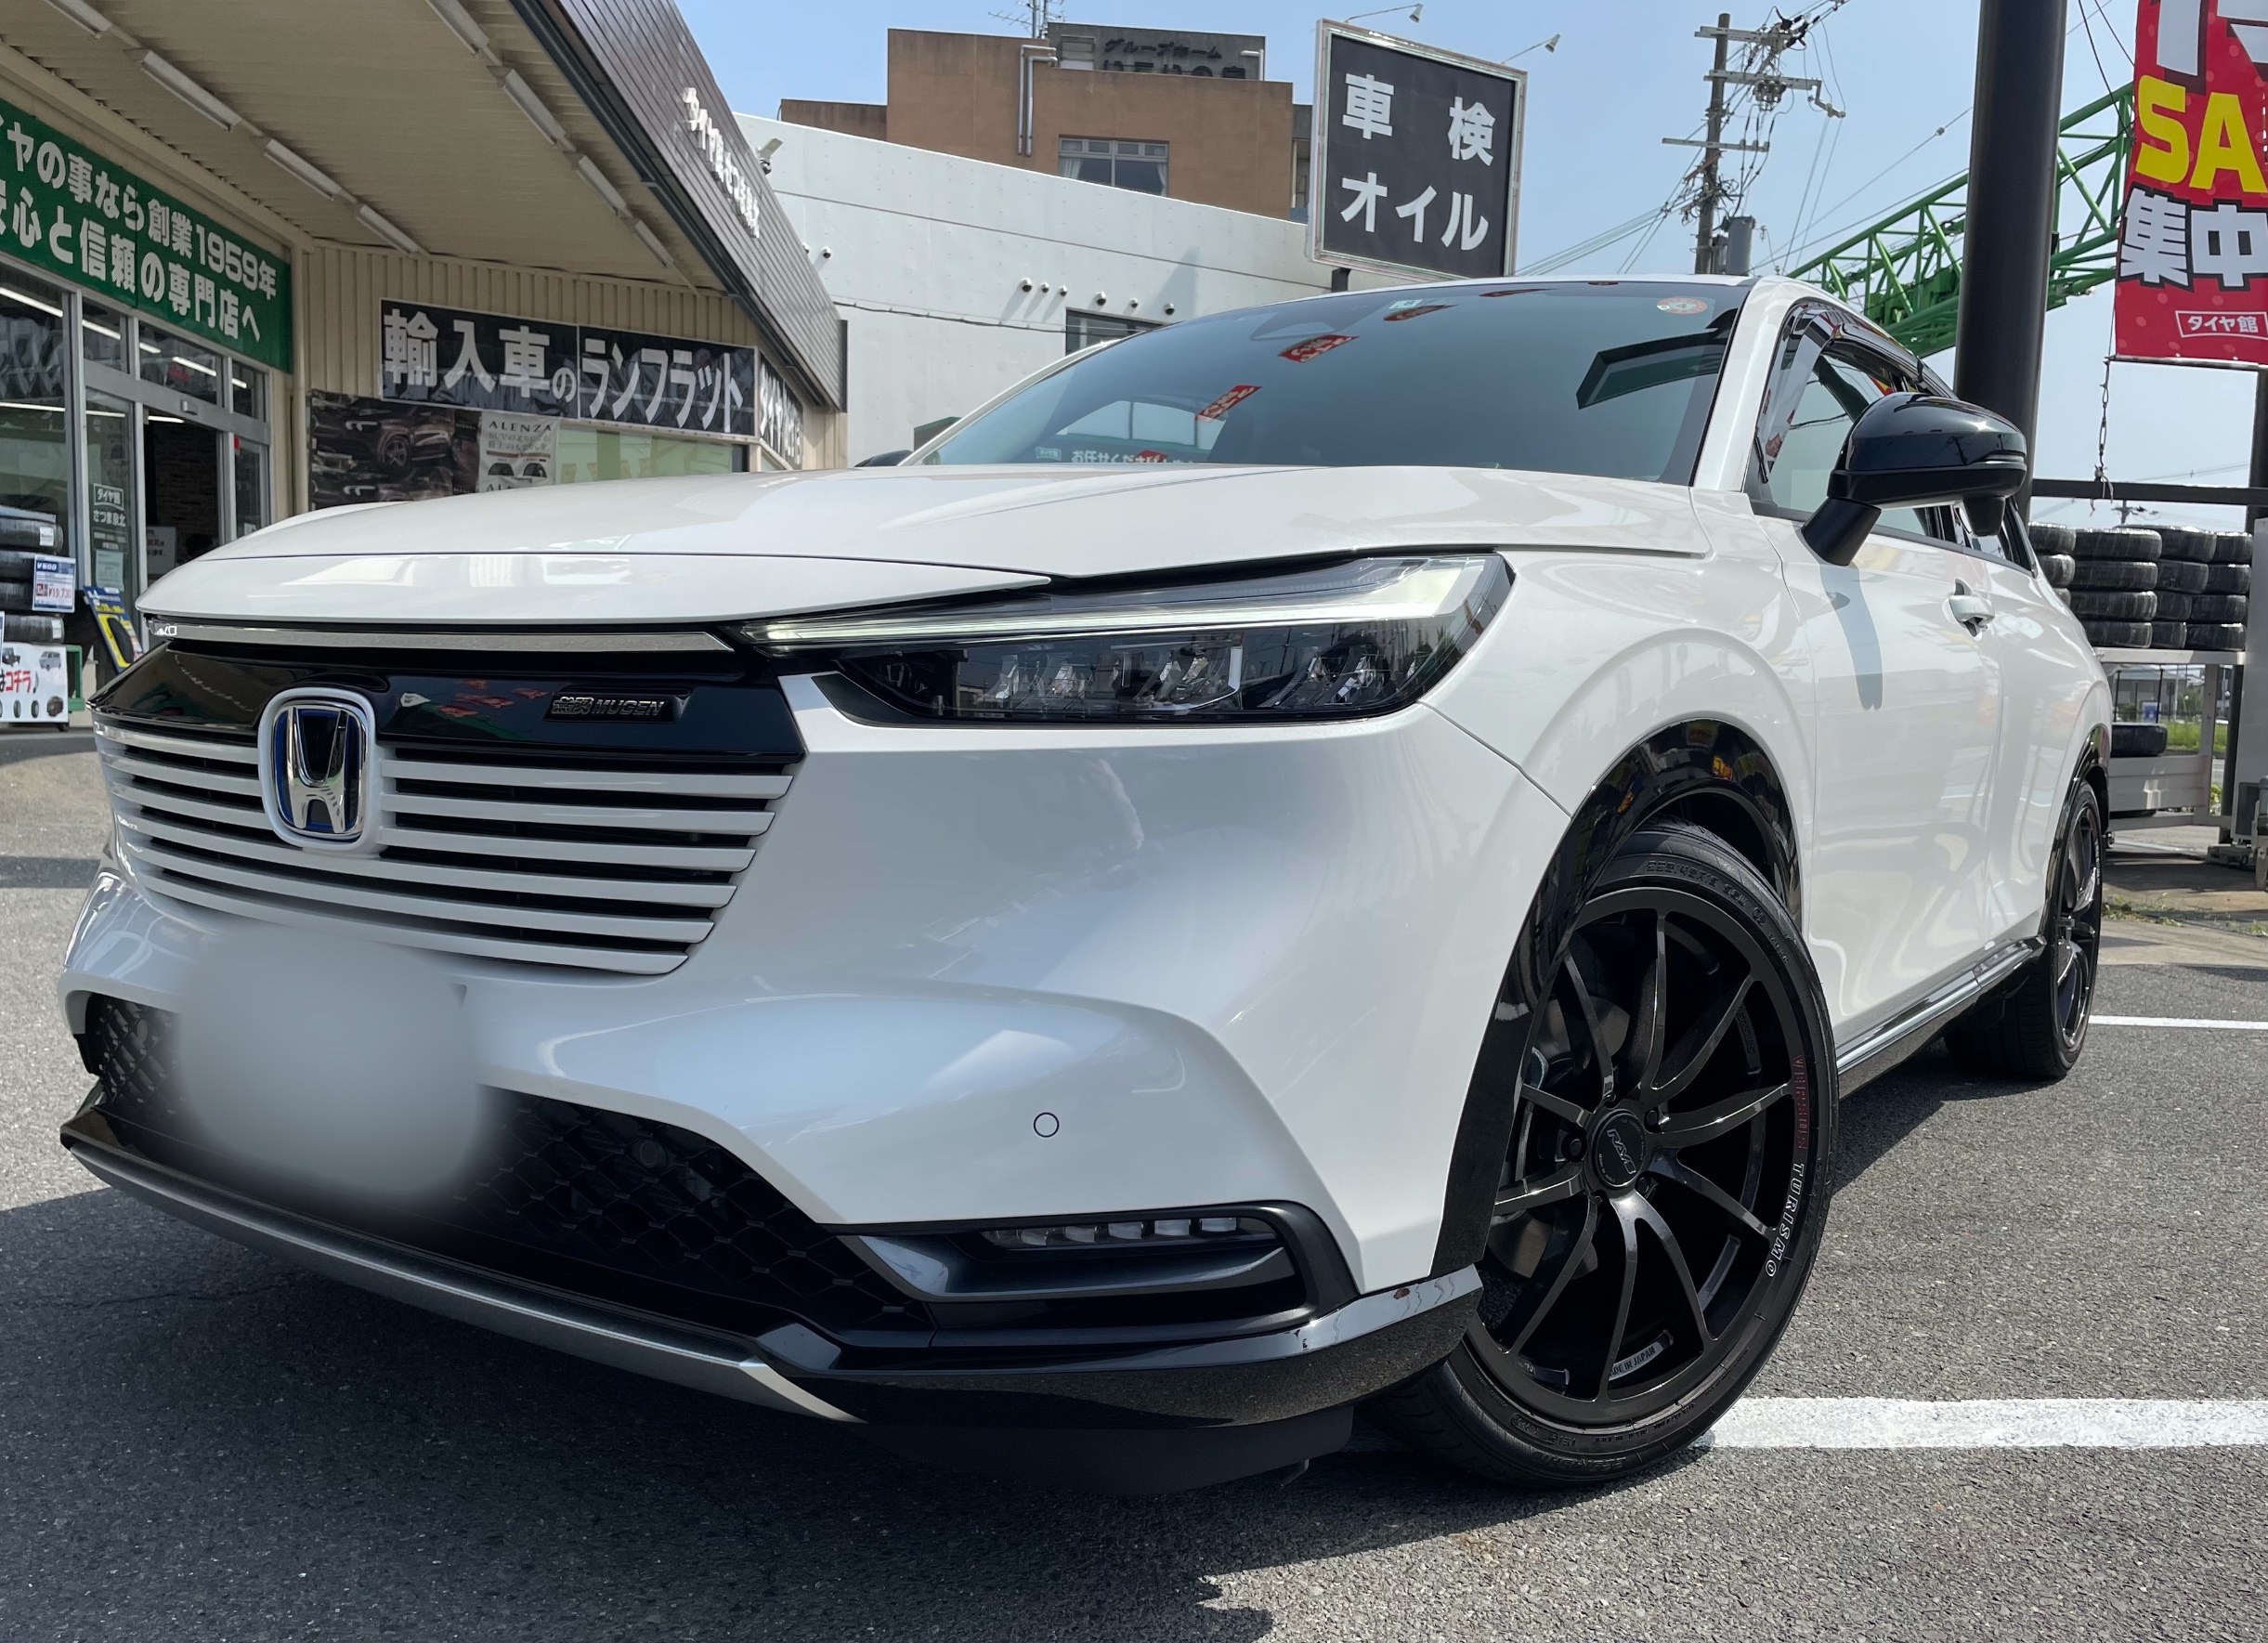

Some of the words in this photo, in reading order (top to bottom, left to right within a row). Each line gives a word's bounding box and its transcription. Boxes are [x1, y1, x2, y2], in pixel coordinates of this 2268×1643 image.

[1340, 172, 1490, 251] オイル
[2120, 187, 2268, 287] 集中
[2187, 315, 2260, 334] タイヤ館
[489, 421, 552, 433] ALENZA
[592, 699, 665, 716] MUGEN
[1792, 1054, 1809, 1151] VERSUS
[1765, 1163, 1805, 1277] TURISMO
[1633, 1345, 1657, 1367] JAPAN
